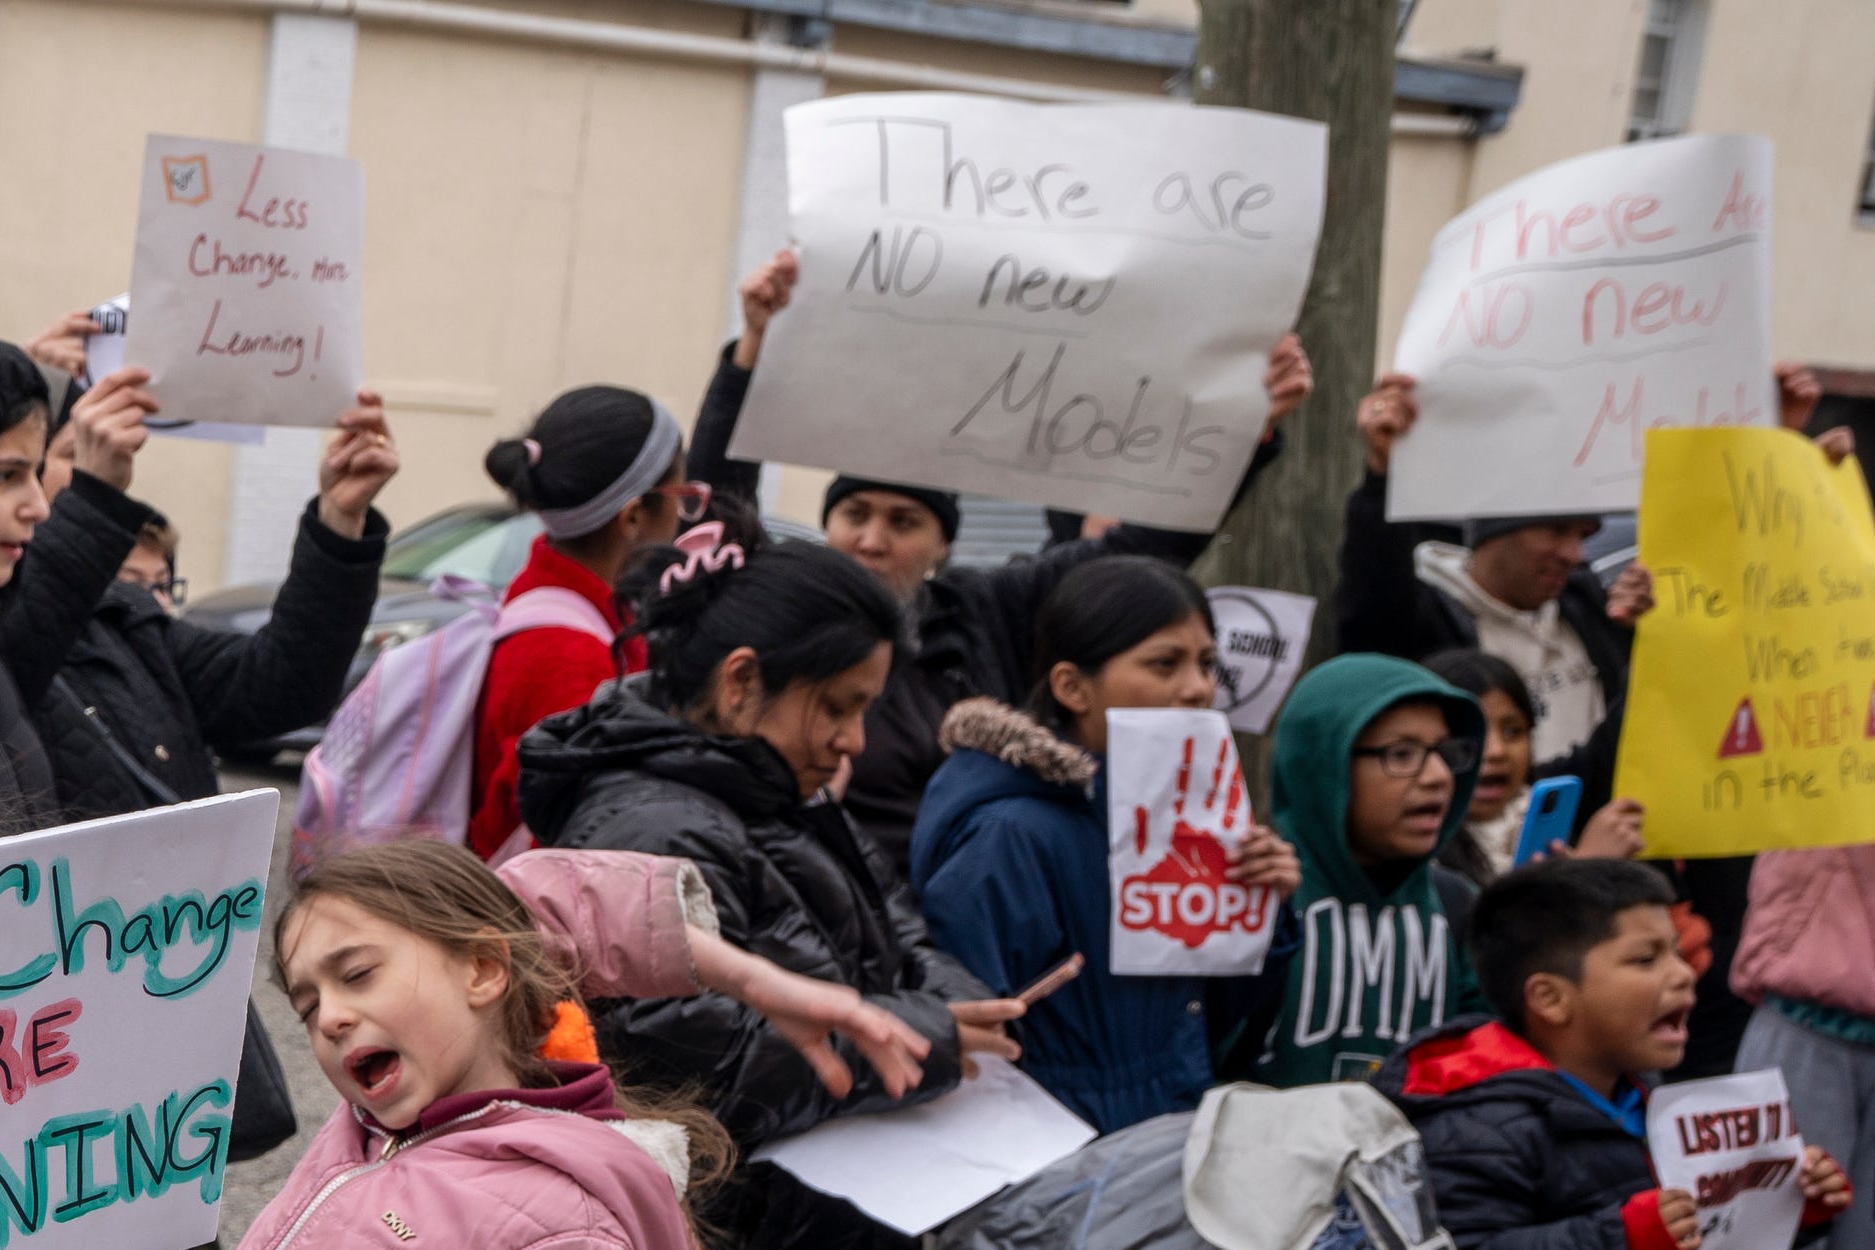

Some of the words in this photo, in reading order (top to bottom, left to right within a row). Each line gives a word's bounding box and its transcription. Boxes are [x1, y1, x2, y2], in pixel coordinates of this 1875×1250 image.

[235, 154, 310, 230] Less
[825, 115, 1103, 221] There
[1153, 169, 1277, 241] are
[1441, 192, 1677, 272] There
[845, 223, 944, 299] NO
[977, 252, 1118, 318] new
[196, 298, 325, 383] Learning!
[1437, 281, 1536, 351] NO
[1581, 276, 1731, 347] new
[1653, 563, 1731, 620] The
[1123, 880, 1263, 930] STOP!
[380, 1210, 417, 1242] DKNY
